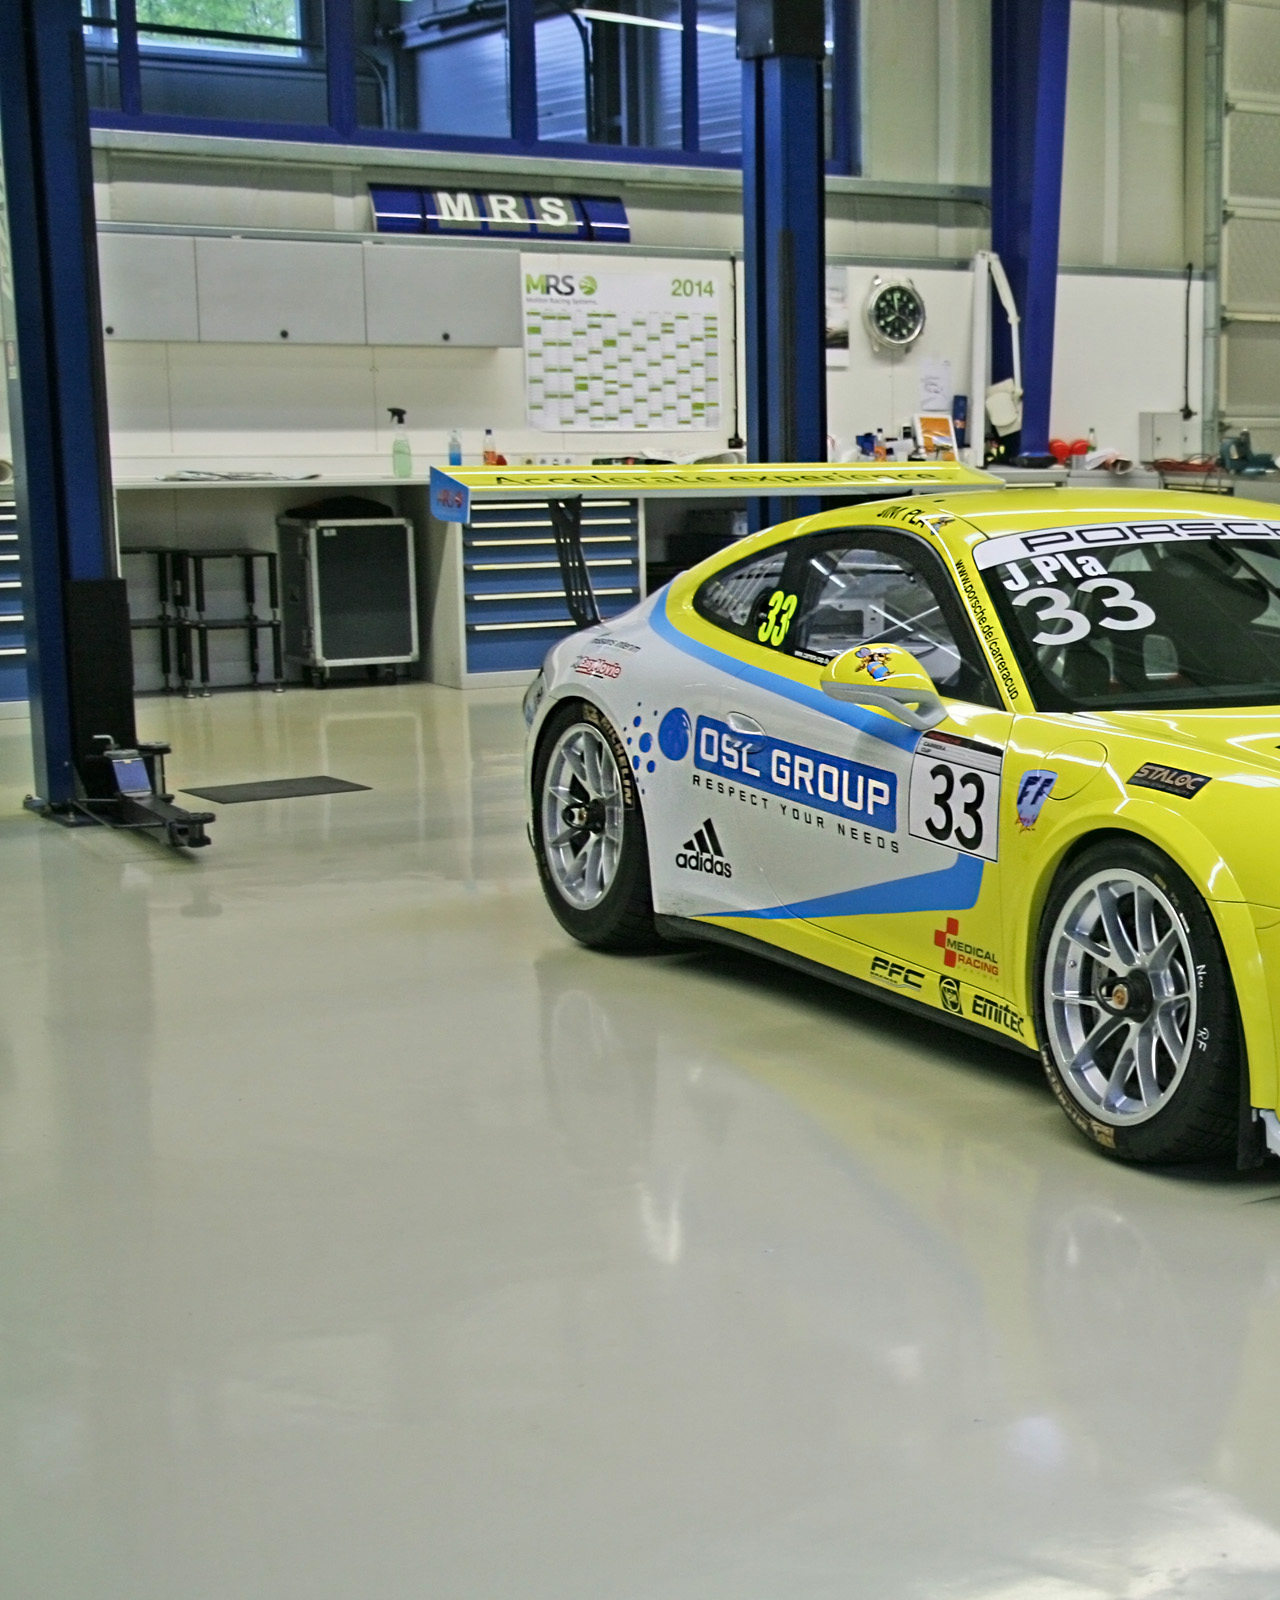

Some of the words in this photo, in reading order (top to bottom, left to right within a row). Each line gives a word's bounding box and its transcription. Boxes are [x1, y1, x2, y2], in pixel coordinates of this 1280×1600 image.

[525, 274, 575, 296] MRS
[671, 278, 715, 297] 2014
[758, 590, 798, 647] 33
[955, 559, 1019, 701] www.porsche.de/carreracup
[1011, 578, 1157, 646] 33
[600, 716, 633, 805] MICHELIN
[701, 727, 761, 777] OSL
[771, 749, 890, 815] GROUP
[1134, 764, 1206, 791] STALOC
[692, 774, 768, 809] RESPECT
[780, 803, 824, 829] YOUR
[837, 823, 899, 854] NEEDS
[925, 764, 985, 851] 33
[675, 851, 732, 879] adidas
[870, 956, 925, 989] PFC
[946, 938, 998, 964] MEDICAL
[957, 954, 999, 976] RACING
